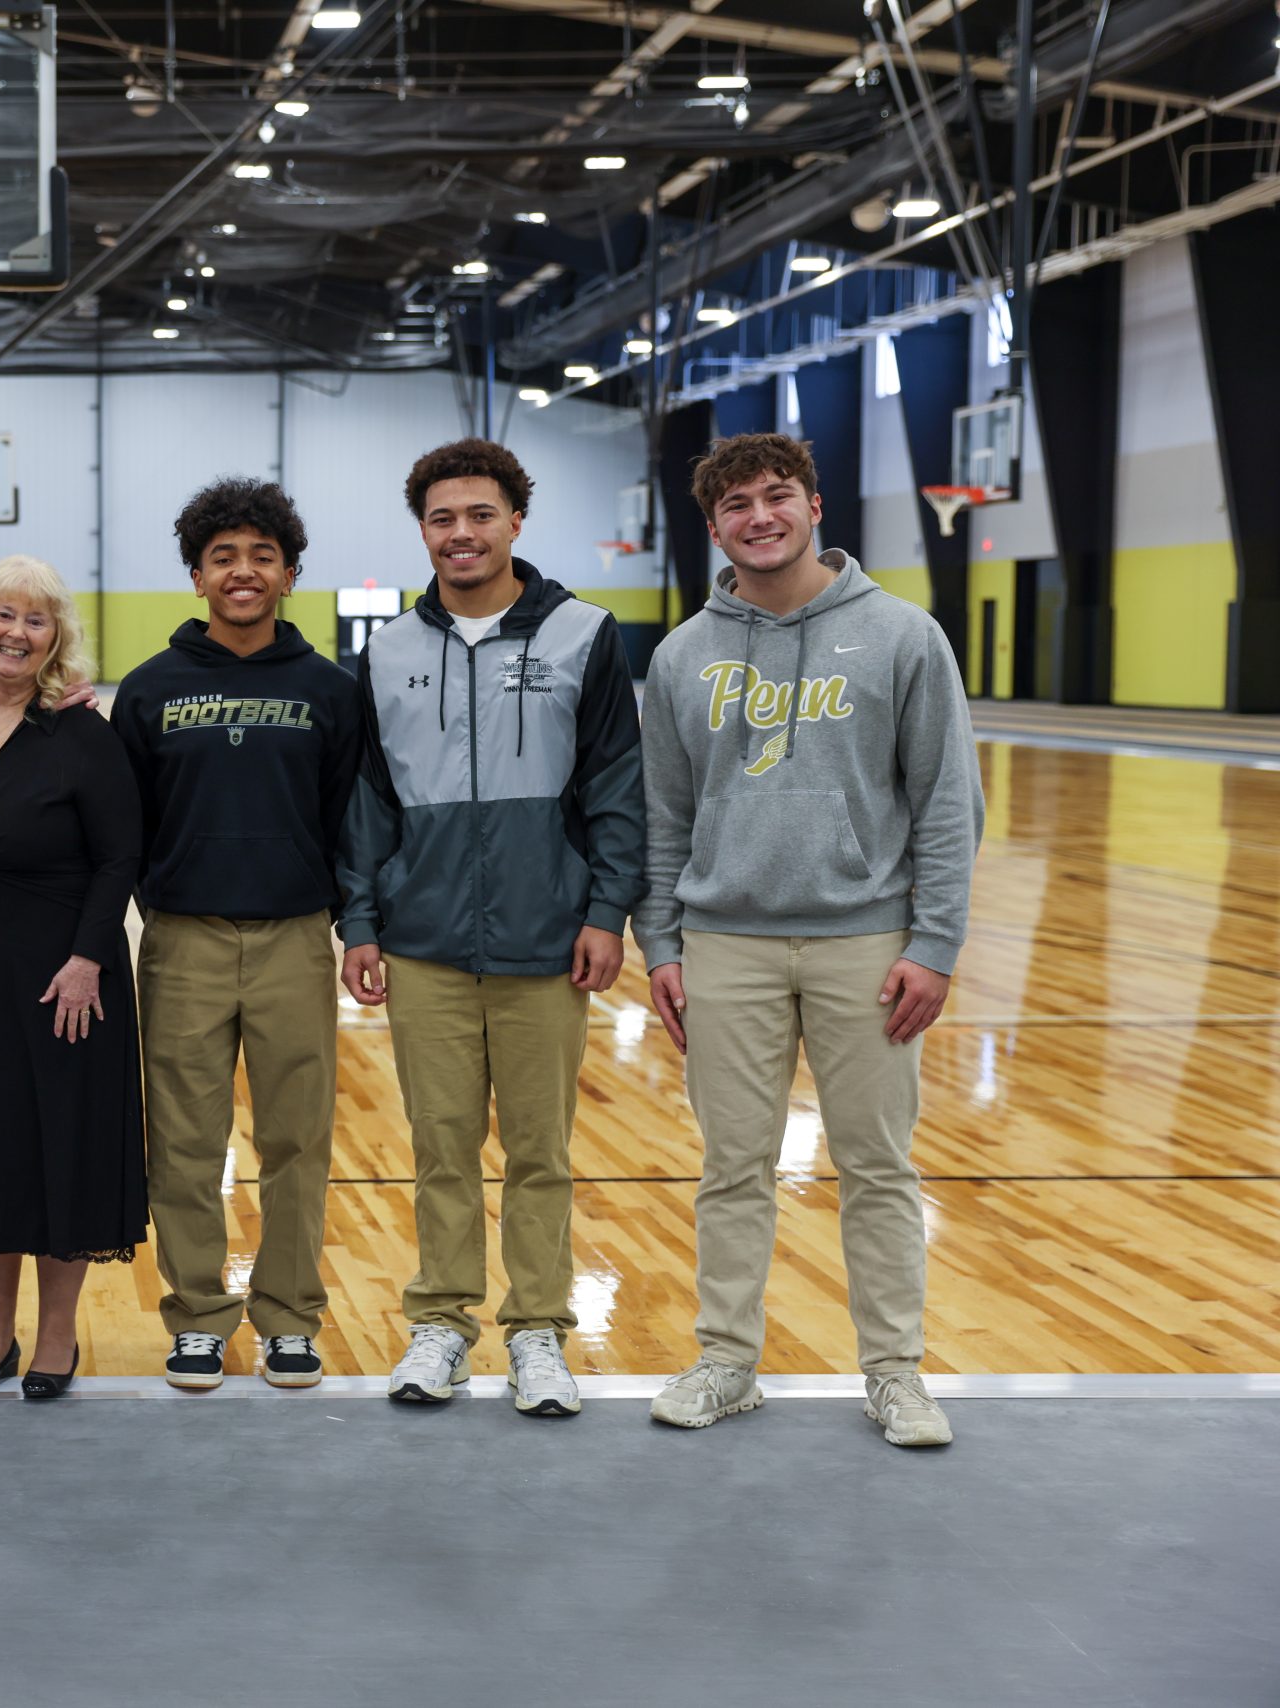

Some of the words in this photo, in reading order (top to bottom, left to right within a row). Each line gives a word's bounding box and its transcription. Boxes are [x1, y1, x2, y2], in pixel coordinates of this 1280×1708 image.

[164, 693, 223, 708] KINGSMEN
[524, 685, 553, 694] FREEMAN
[699, 660, 854, 731] Penn
[162, 699, 313, 732] FOOTBALL
